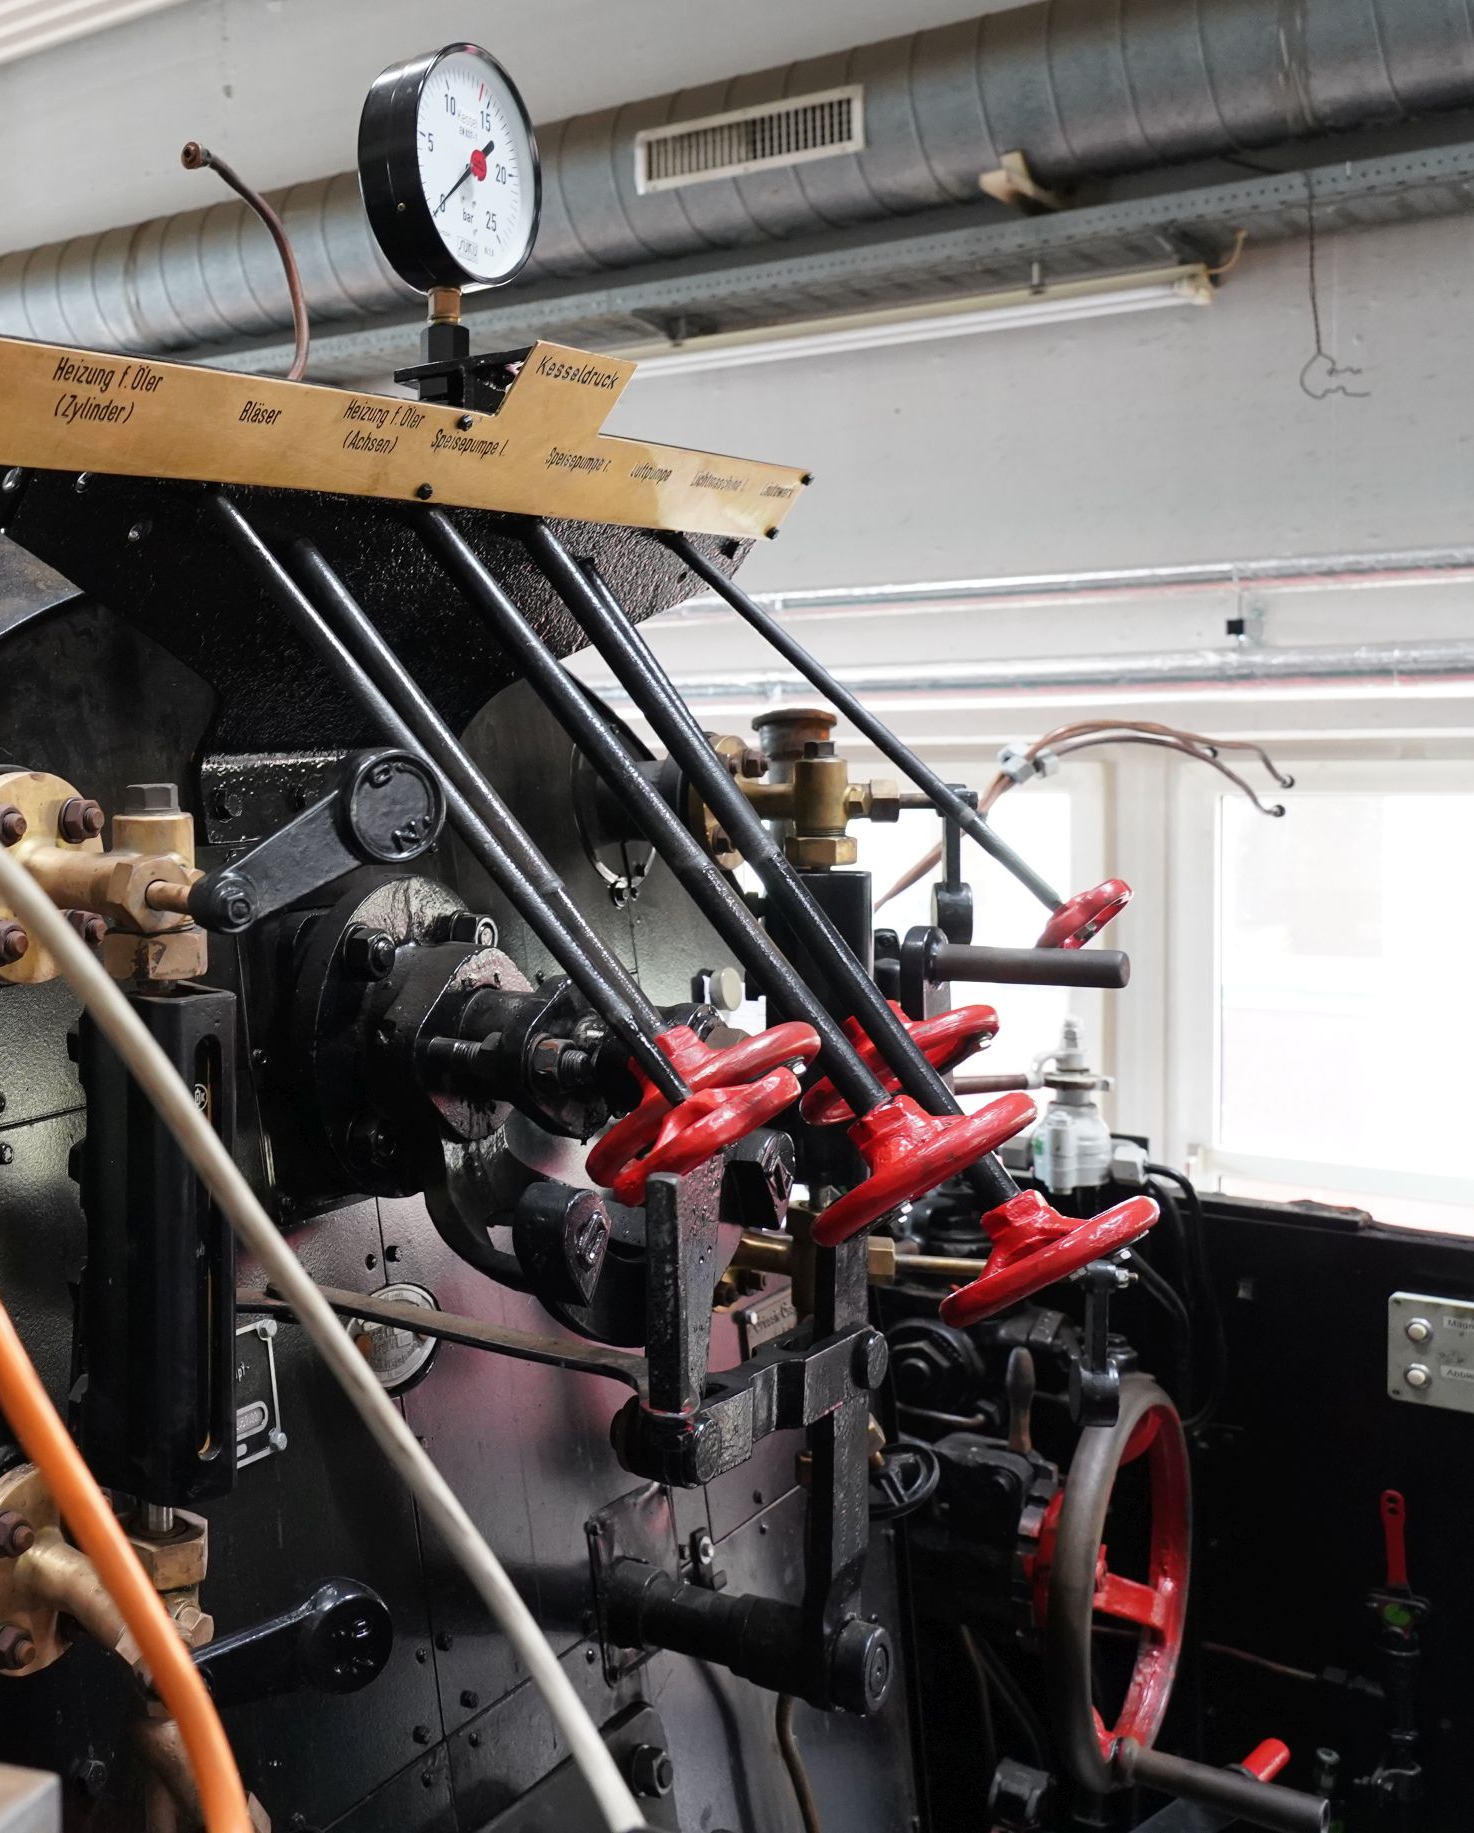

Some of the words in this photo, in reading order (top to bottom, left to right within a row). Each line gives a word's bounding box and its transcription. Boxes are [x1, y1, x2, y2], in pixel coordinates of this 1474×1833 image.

[444, 94, 456, 116] 10
[480, 110, 491, 132] 15
[427, 132, 434, 152] 5
[495, 163, 506, 185] 20
[462, 208, 474, 224] bar
[486, 210, 497, 232] 25
[52, 357, 116, 393] Heizung
[535, 355, 620, 389] Kesseldruck
[54, 393, 135, 424] (Zylinder)
[239, 400, 283, 425] Bläser
[342, 399, 390, 429] Heizung
[342, 430, 399, 455] (Achsen)
[430, 428, 500, 460] Speisepumpe
[544, 446, 605, 475] Speisepumpe
[629, 460, 673, 486] Luftpumpe
